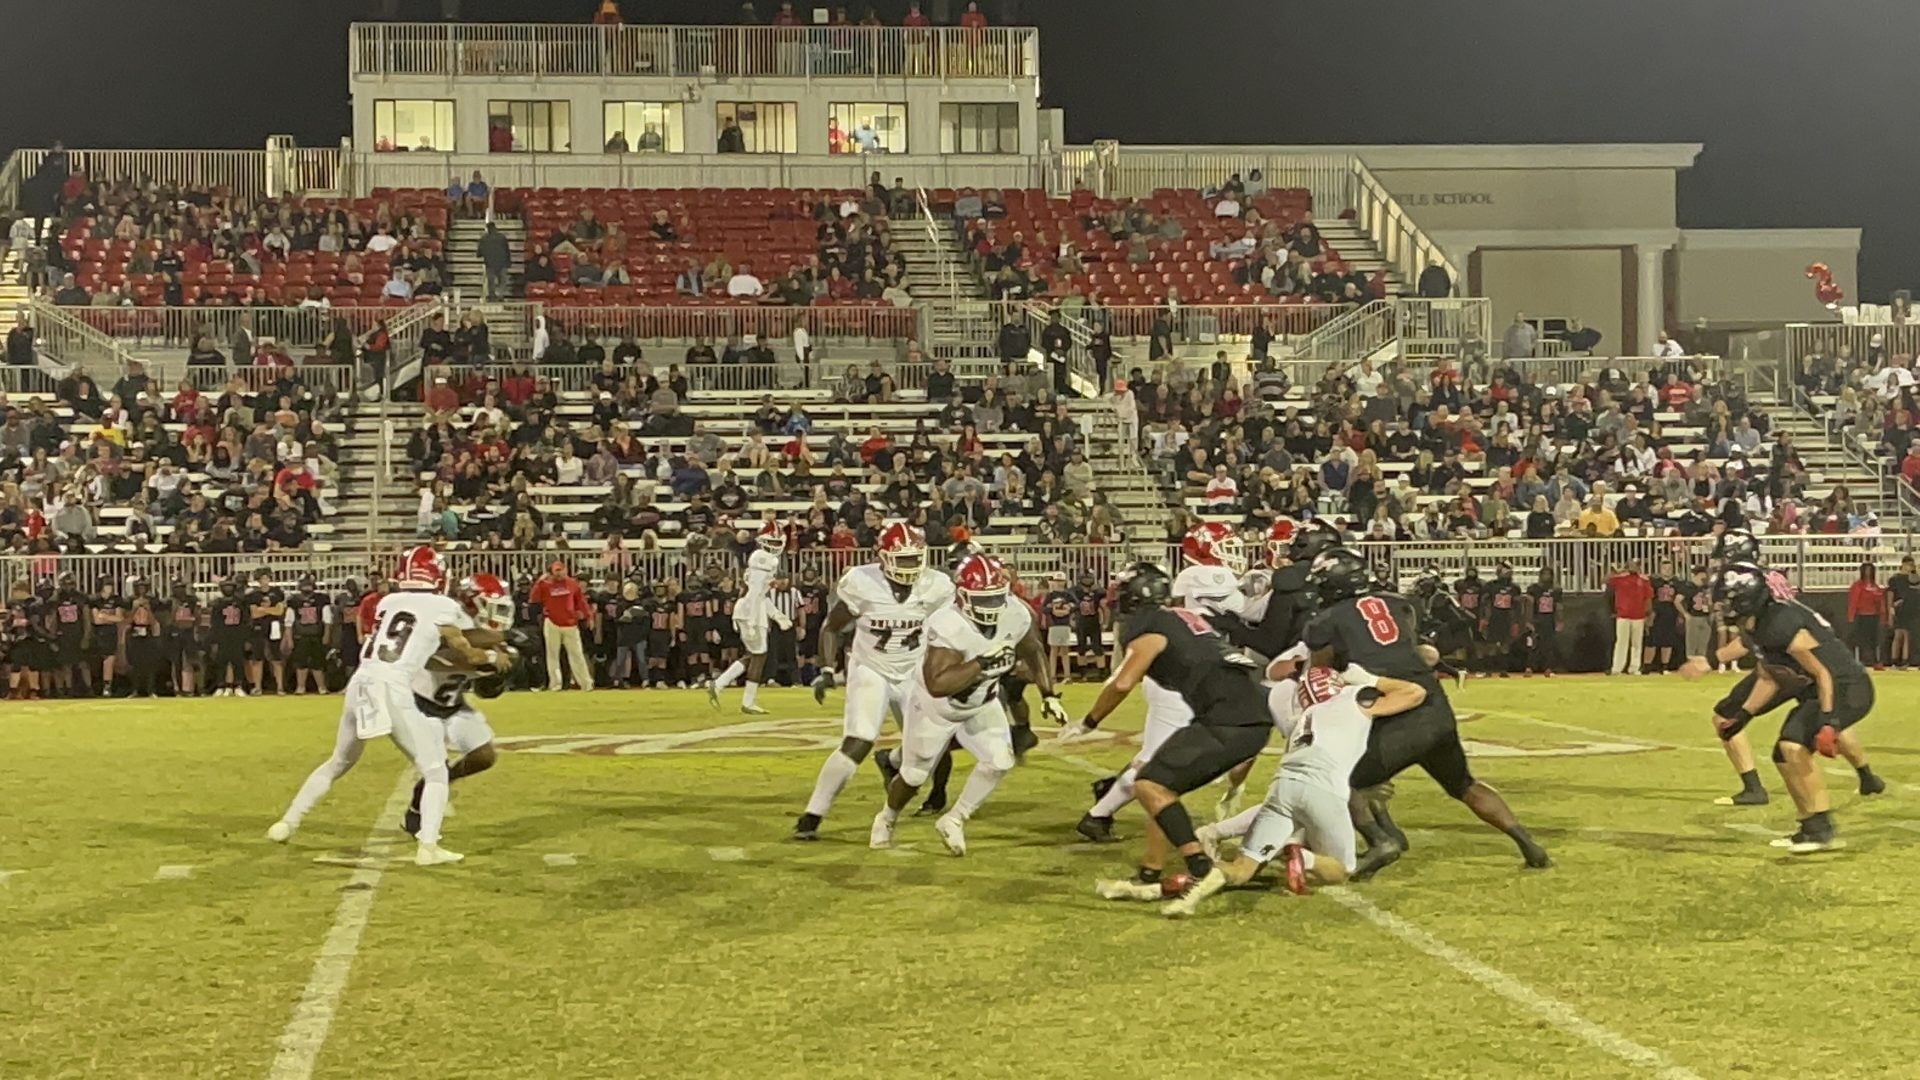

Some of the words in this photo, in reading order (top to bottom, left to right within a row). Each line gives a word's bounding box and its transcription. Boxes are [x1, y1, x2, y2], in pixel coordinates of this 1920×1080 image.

[1433, 193, 1494, 205] SCHOOL
[363, 609, 417, 663] 19
[1356, 596, 1399, 645] 8
[870, 628, 922, 653] 74
